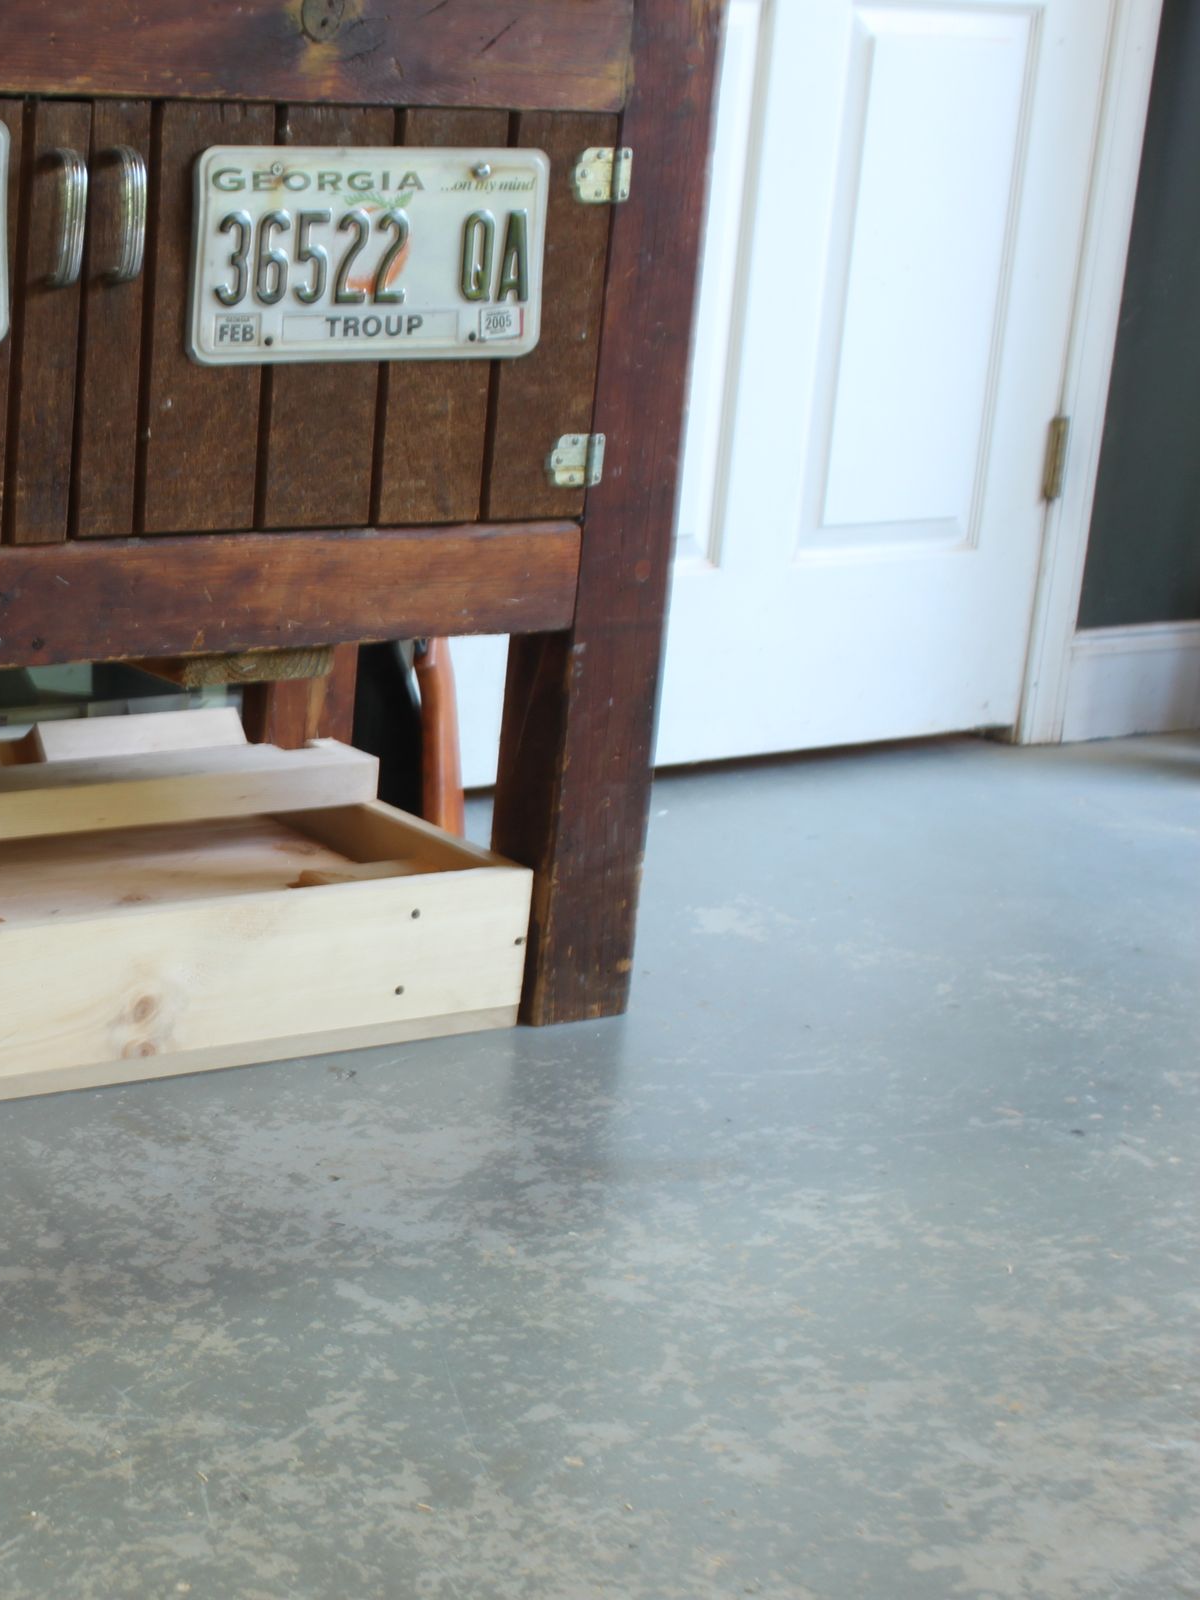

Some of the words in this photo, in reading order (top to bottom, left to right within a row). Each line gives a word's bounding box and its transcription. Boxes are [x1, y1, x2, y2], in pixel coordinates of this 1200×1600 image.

[212, 167, 425, 192] GEORGIA
[475, 180, 497, 195] my
[498, 176, 536, 191] mind
[214, 208, 410, 305] 36522
[461, 208, 529, 303] QA
[219, 324, 255, 342] FEB
[325, 314, 423, 339] TROUP
[485, 314, 512, 330] 2005
